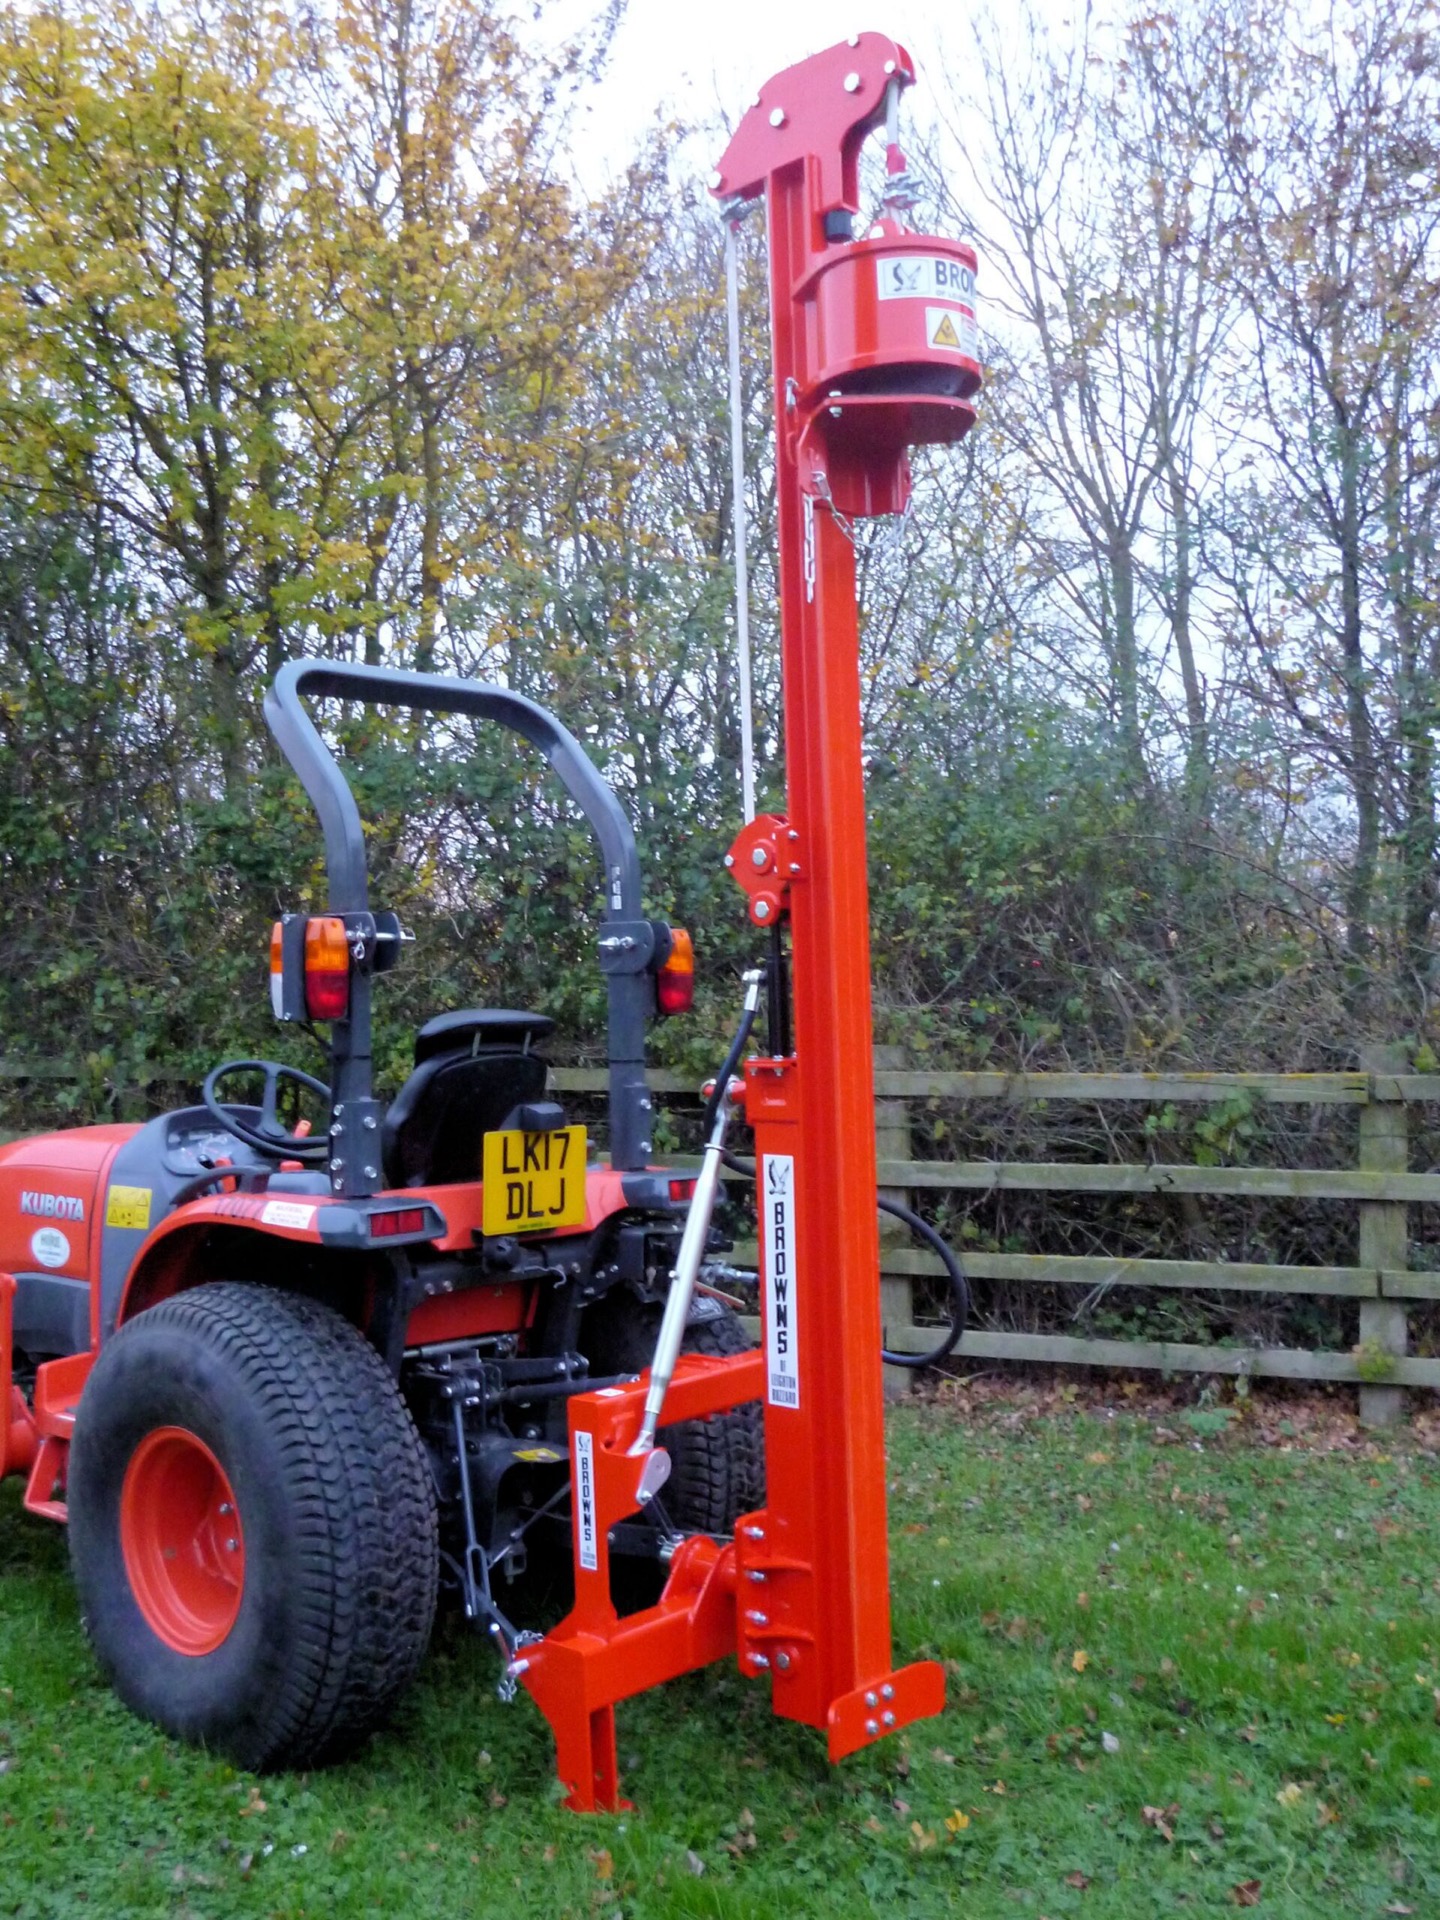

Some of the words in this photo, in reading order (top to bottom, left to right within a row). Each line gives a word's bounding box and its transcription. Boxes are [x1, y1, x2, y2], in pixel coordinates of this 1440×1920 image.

[502, 1132, 570, 1174] LK17
[21, 1191, 85, 1222] KUBOTA
[506, 1177, 565, 1220] DLJ
[774, 1201, 788, 1354] BROWNS
[581, 1457, 592, 1541] BROWNS
